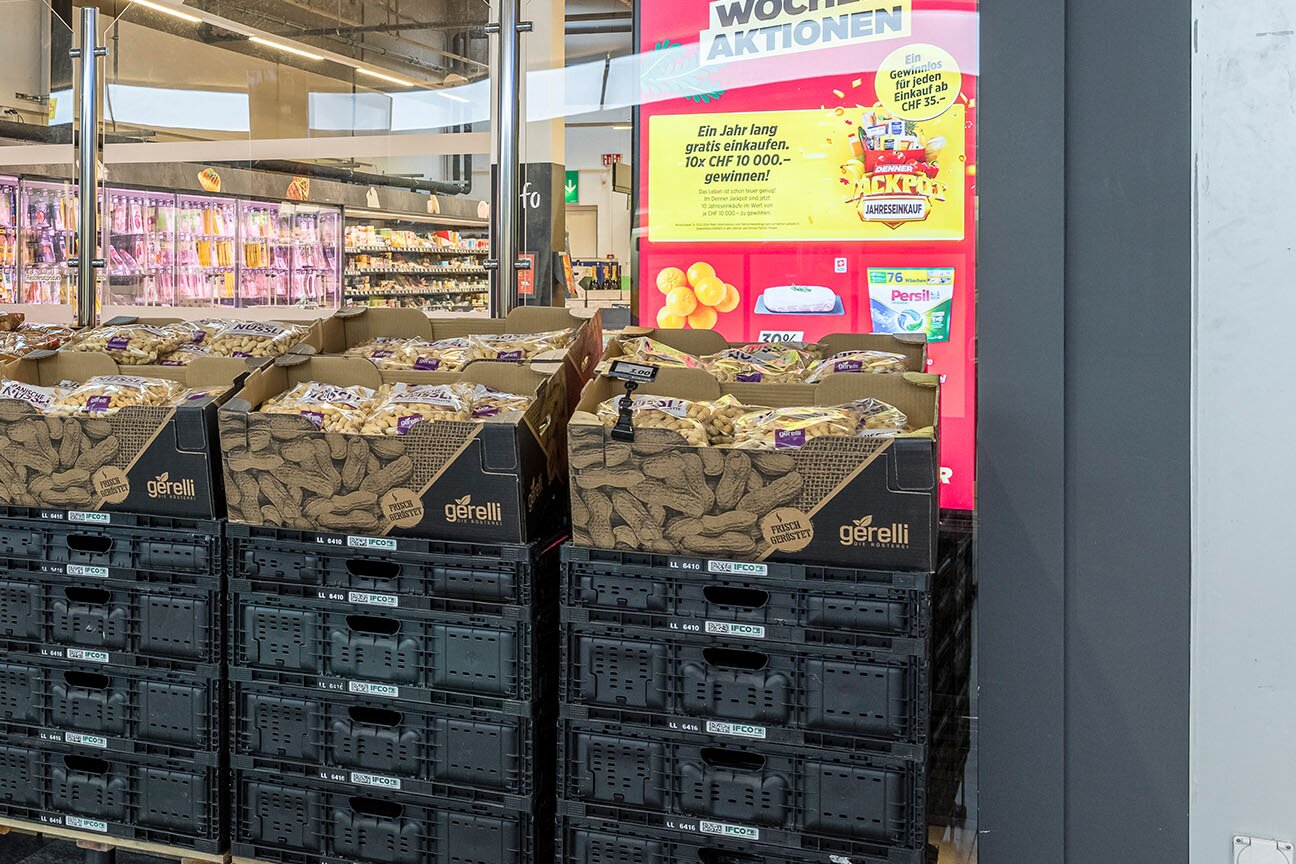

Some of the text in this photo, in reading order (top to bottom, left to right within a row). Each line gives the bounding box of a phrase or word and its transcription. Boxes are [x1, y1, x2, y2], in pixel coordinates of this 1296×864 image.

[707, 6, 902, 60] AKTIONEN
[905, 53, 921, 65] Ein
[890, 60, 943, 80] Gewinnlos
[896, 73, 941, 90] für jeden
[894, 81, 948, 102] Einkauf ab
[901, 98, 922, 111] CHF
[698, 124, 778, 137] Ein Jahr lang
[685, 138, 790, 154] gratis einkaufen.
[685, 156, 706, 168] 10x
[708, 155, 734, 167] CHF
[736, 154, 750, 166] 10
[875, 165, 913, 173] DENNER
[704, 170, 771, 184] gewinnen!
[866, 204, 922, 214] JAHRESEINKAUF
[887, 272, 903, 282] 76
[891, 289, 930, 301] Persil
[100, 477, 121, 489] FRISCH
[147, 478, 195, 498] gerelli
[100, 484, 129, 497] GERÖSTET
[388, 499, 413, 512] FRISCH
[445, 502, 502, 522] gerelli
[389, 507, 422, 521] GERÖSTET
[770, 521, 801, 534] FRISCH
[839, 523, 909, 545] gerelli
[770, 529, 812, 545] GERÖSTET
[734, 563, 754, 571] IFCO
[731, 625, 751, 633] IFCO
[733, 725, 754, 733] IFCO
[725, 825, 746, 834] IFCO
